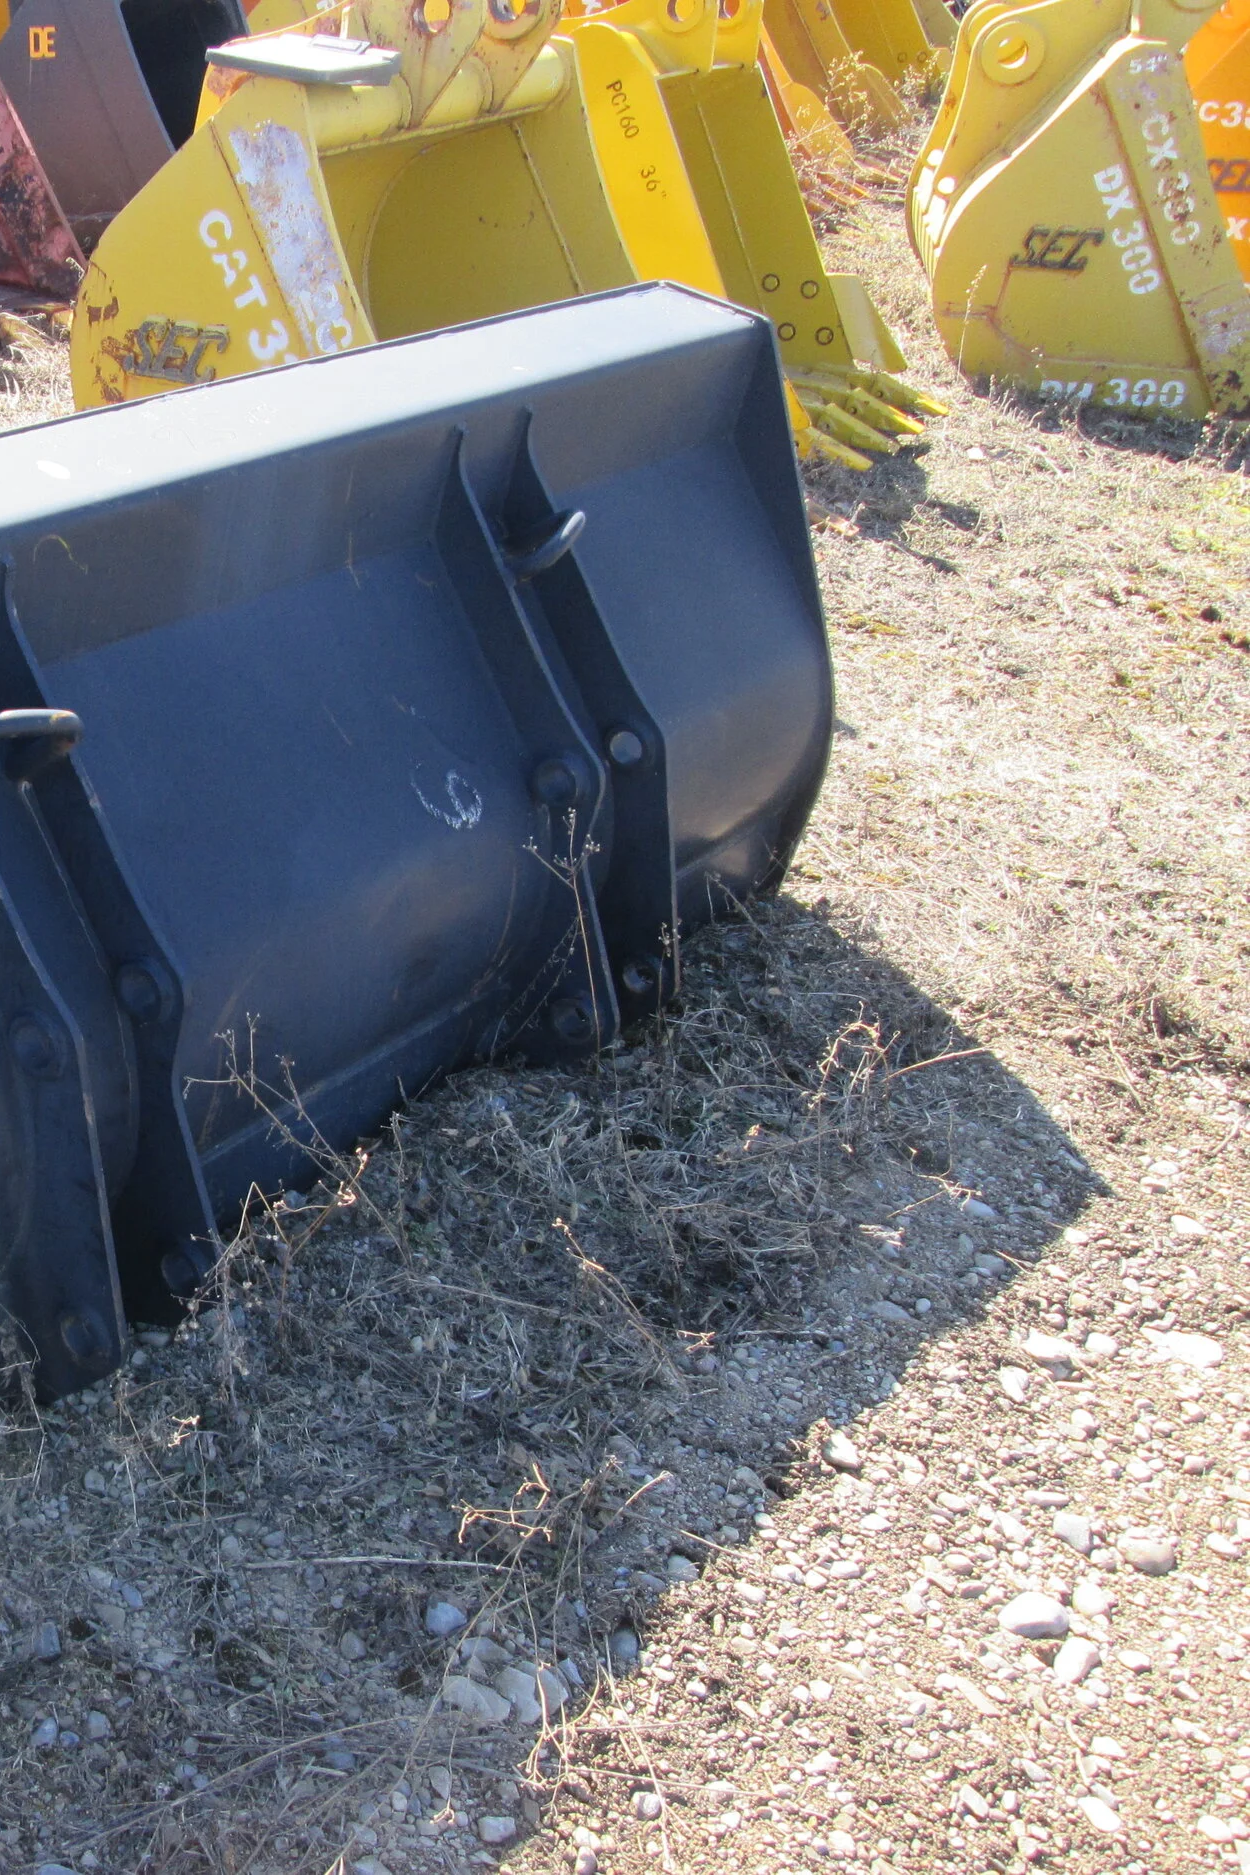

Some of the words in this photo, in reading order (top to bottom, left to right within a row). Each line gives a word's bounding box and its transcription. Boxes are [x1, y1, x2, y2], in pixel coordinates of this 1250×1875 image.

[28, 25, 57, 59] DE
[606, 79, 640, 139] PC160
[1093, 163, 1136, 221] DX
[198, 209, 268, 311] CAT
[1111, 219, 1162, 295] 300
[1102, 377, 1188, 409] 300
